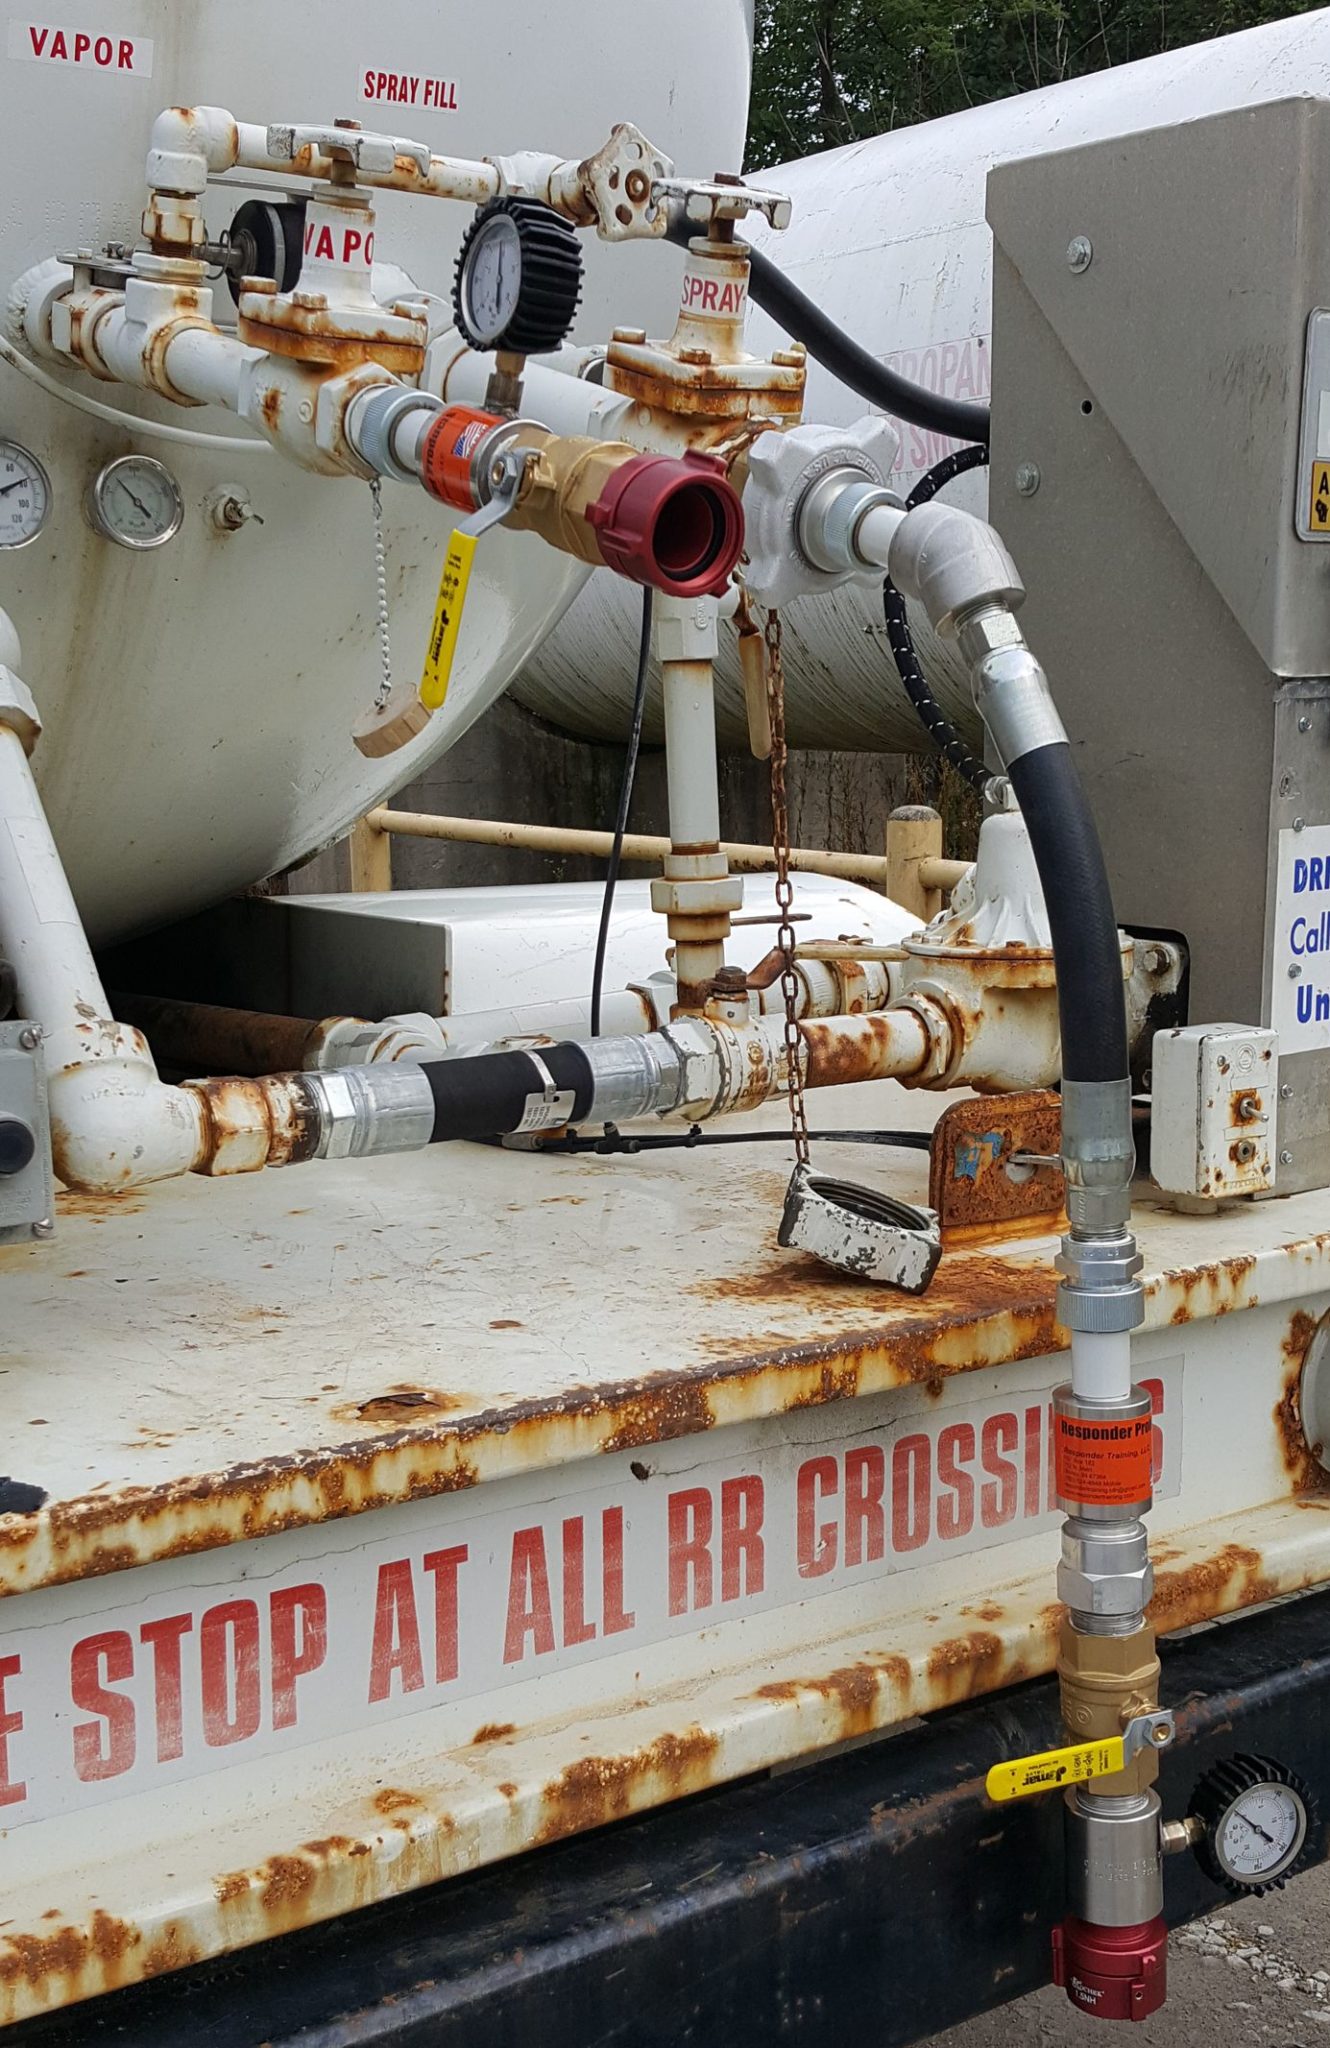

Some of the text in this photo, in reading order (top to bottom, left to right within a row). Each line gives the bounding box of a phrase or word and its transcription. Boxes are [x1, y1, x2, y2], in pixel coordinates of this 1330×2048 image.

[29, 26, 135, 69] VAPOR
[364, 70, 458, 109] SPRAY FILL
[1290, 910, 1330, 955] Call
[1061, 1420, 1133, 1441] Responder
[70, 1582, 328, 1783] STOP
[367, 1543, 469, 1704] AT
[503, 1505, 636, 1665] ALL
[667, 1474, 765, 1617] RR
[796, 1378, 1164, 1579] CROSSI
